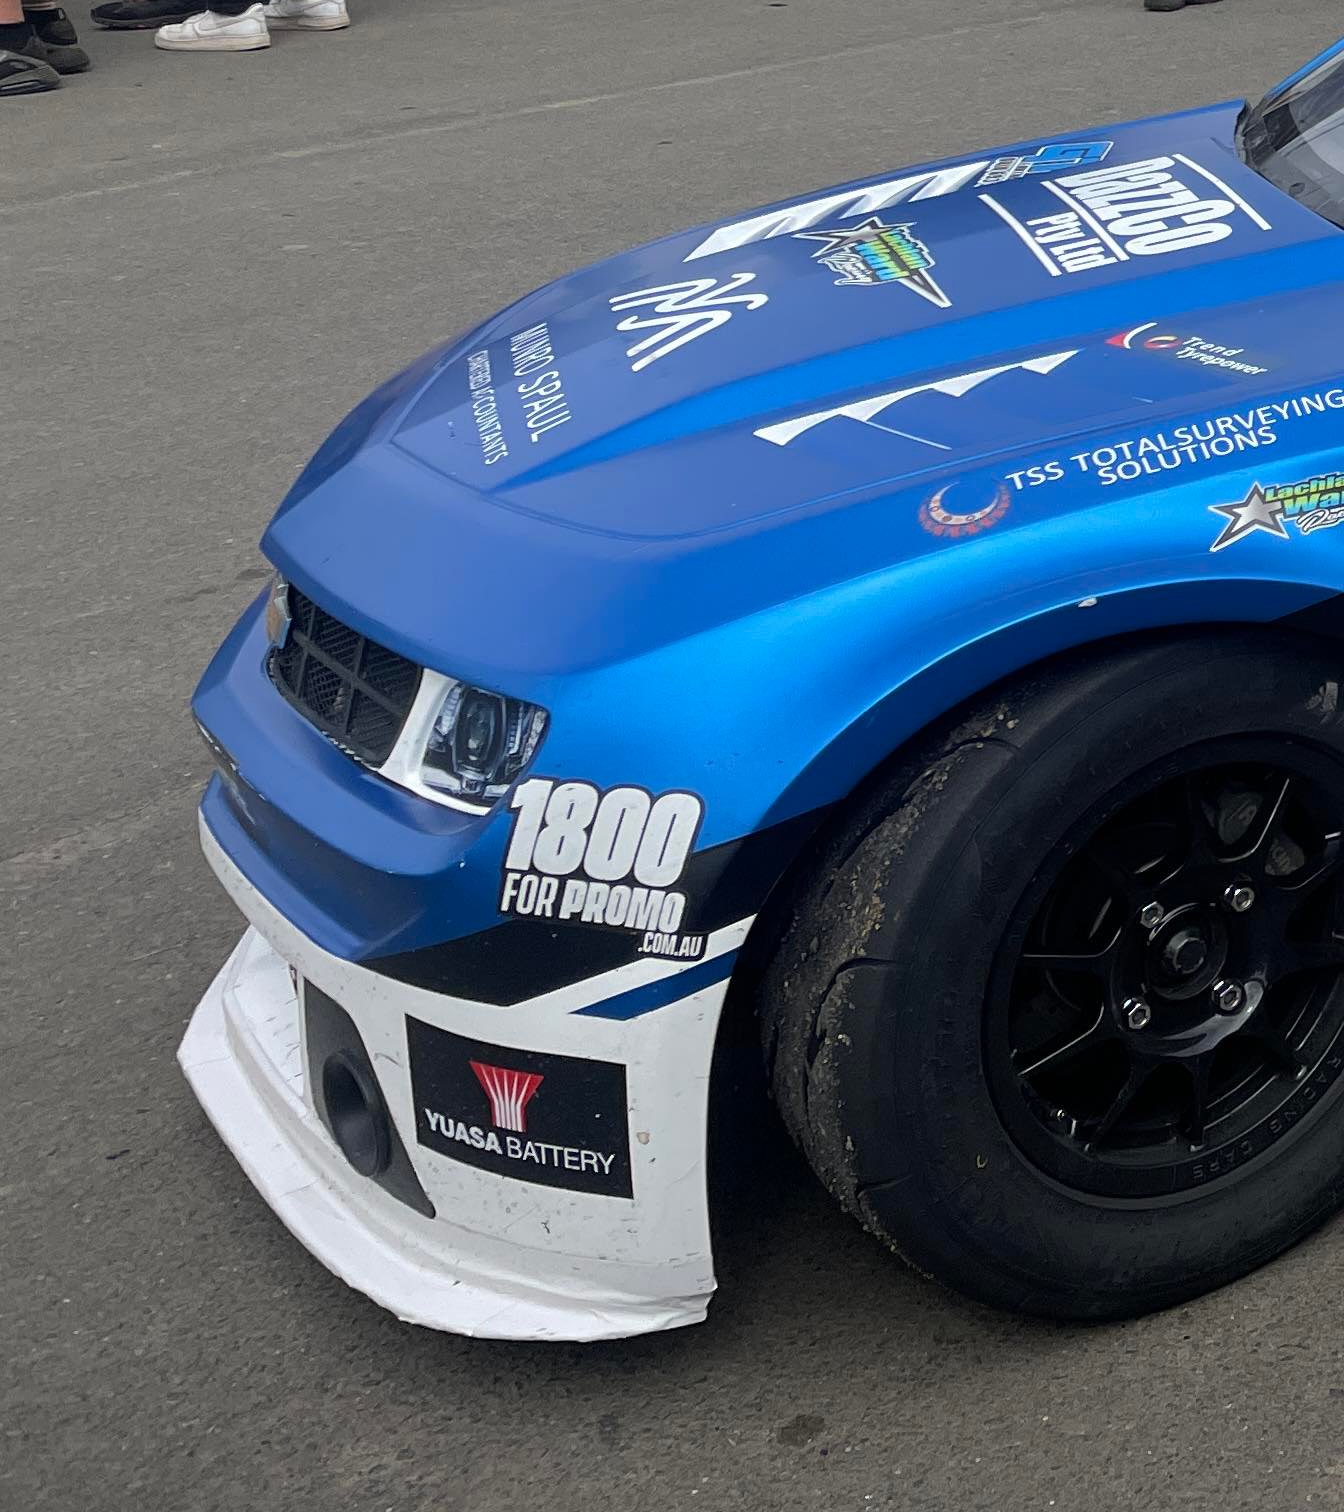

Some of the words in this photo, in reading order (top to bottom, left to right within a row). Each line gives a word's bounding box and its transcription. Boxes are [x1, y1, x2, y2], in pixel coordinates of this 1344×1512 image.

[1026, 211, 1086, 244] Pty
[1049, 236, 1119, 273] Ltd
[1175, 346, 1269, 375] Tyrepower
[1182, 336, 1245, 357] Trend
[517, 370, 573, 443] SPAUL
[1098, 425, 1278, 486] SOLUTIONS
[1005, 461, 1064, 492] TSS
[504, 778, 703, 888] 1800
[501, 872, 560, 918] FOR
[558, 880, 687, 934] PROMO
[637, 931, 704, 958] .COM.AU
[424, 1107, 504, 1156] YUASA
[506, 1136, 617, 1176] BATTERY
